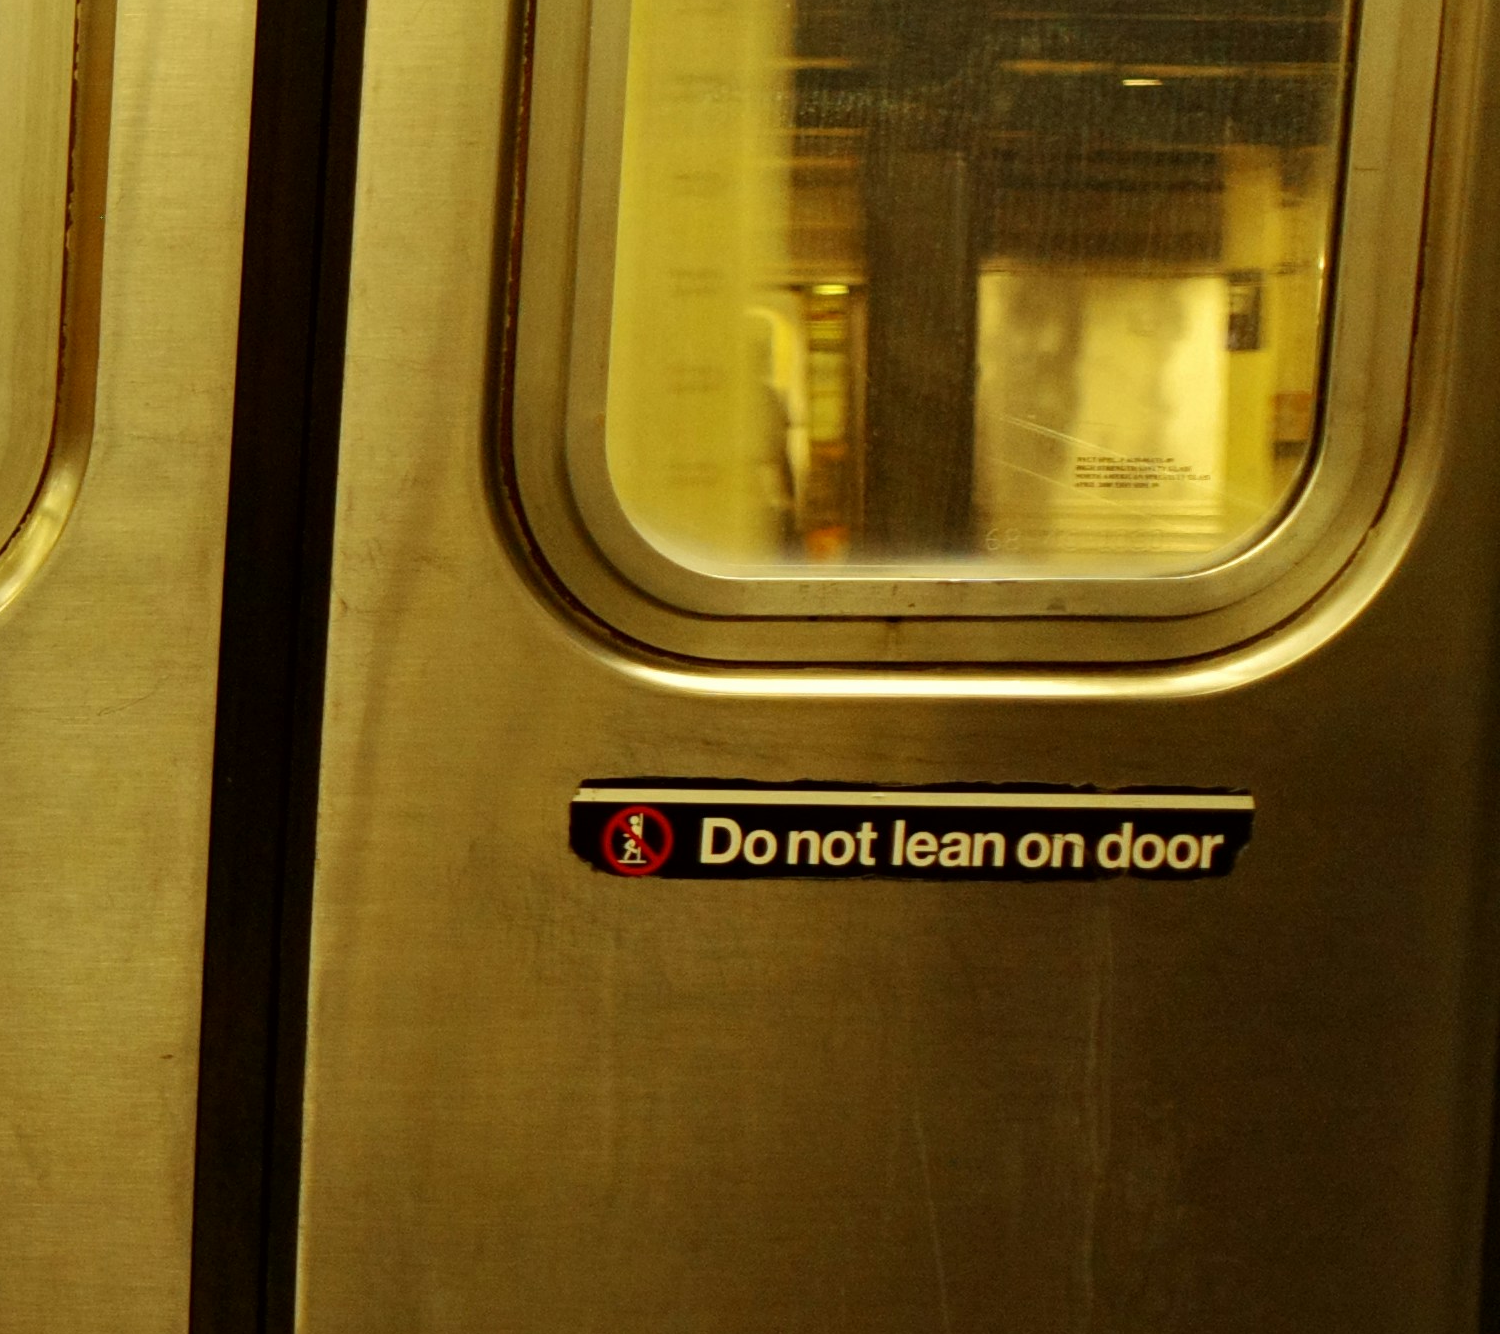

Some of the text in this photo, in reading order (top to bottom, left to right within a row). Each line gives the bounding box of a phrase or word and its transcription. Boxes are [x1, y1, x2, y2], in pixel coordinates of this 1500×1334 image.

[700, 817, 1224, 870] Do not lean on door
